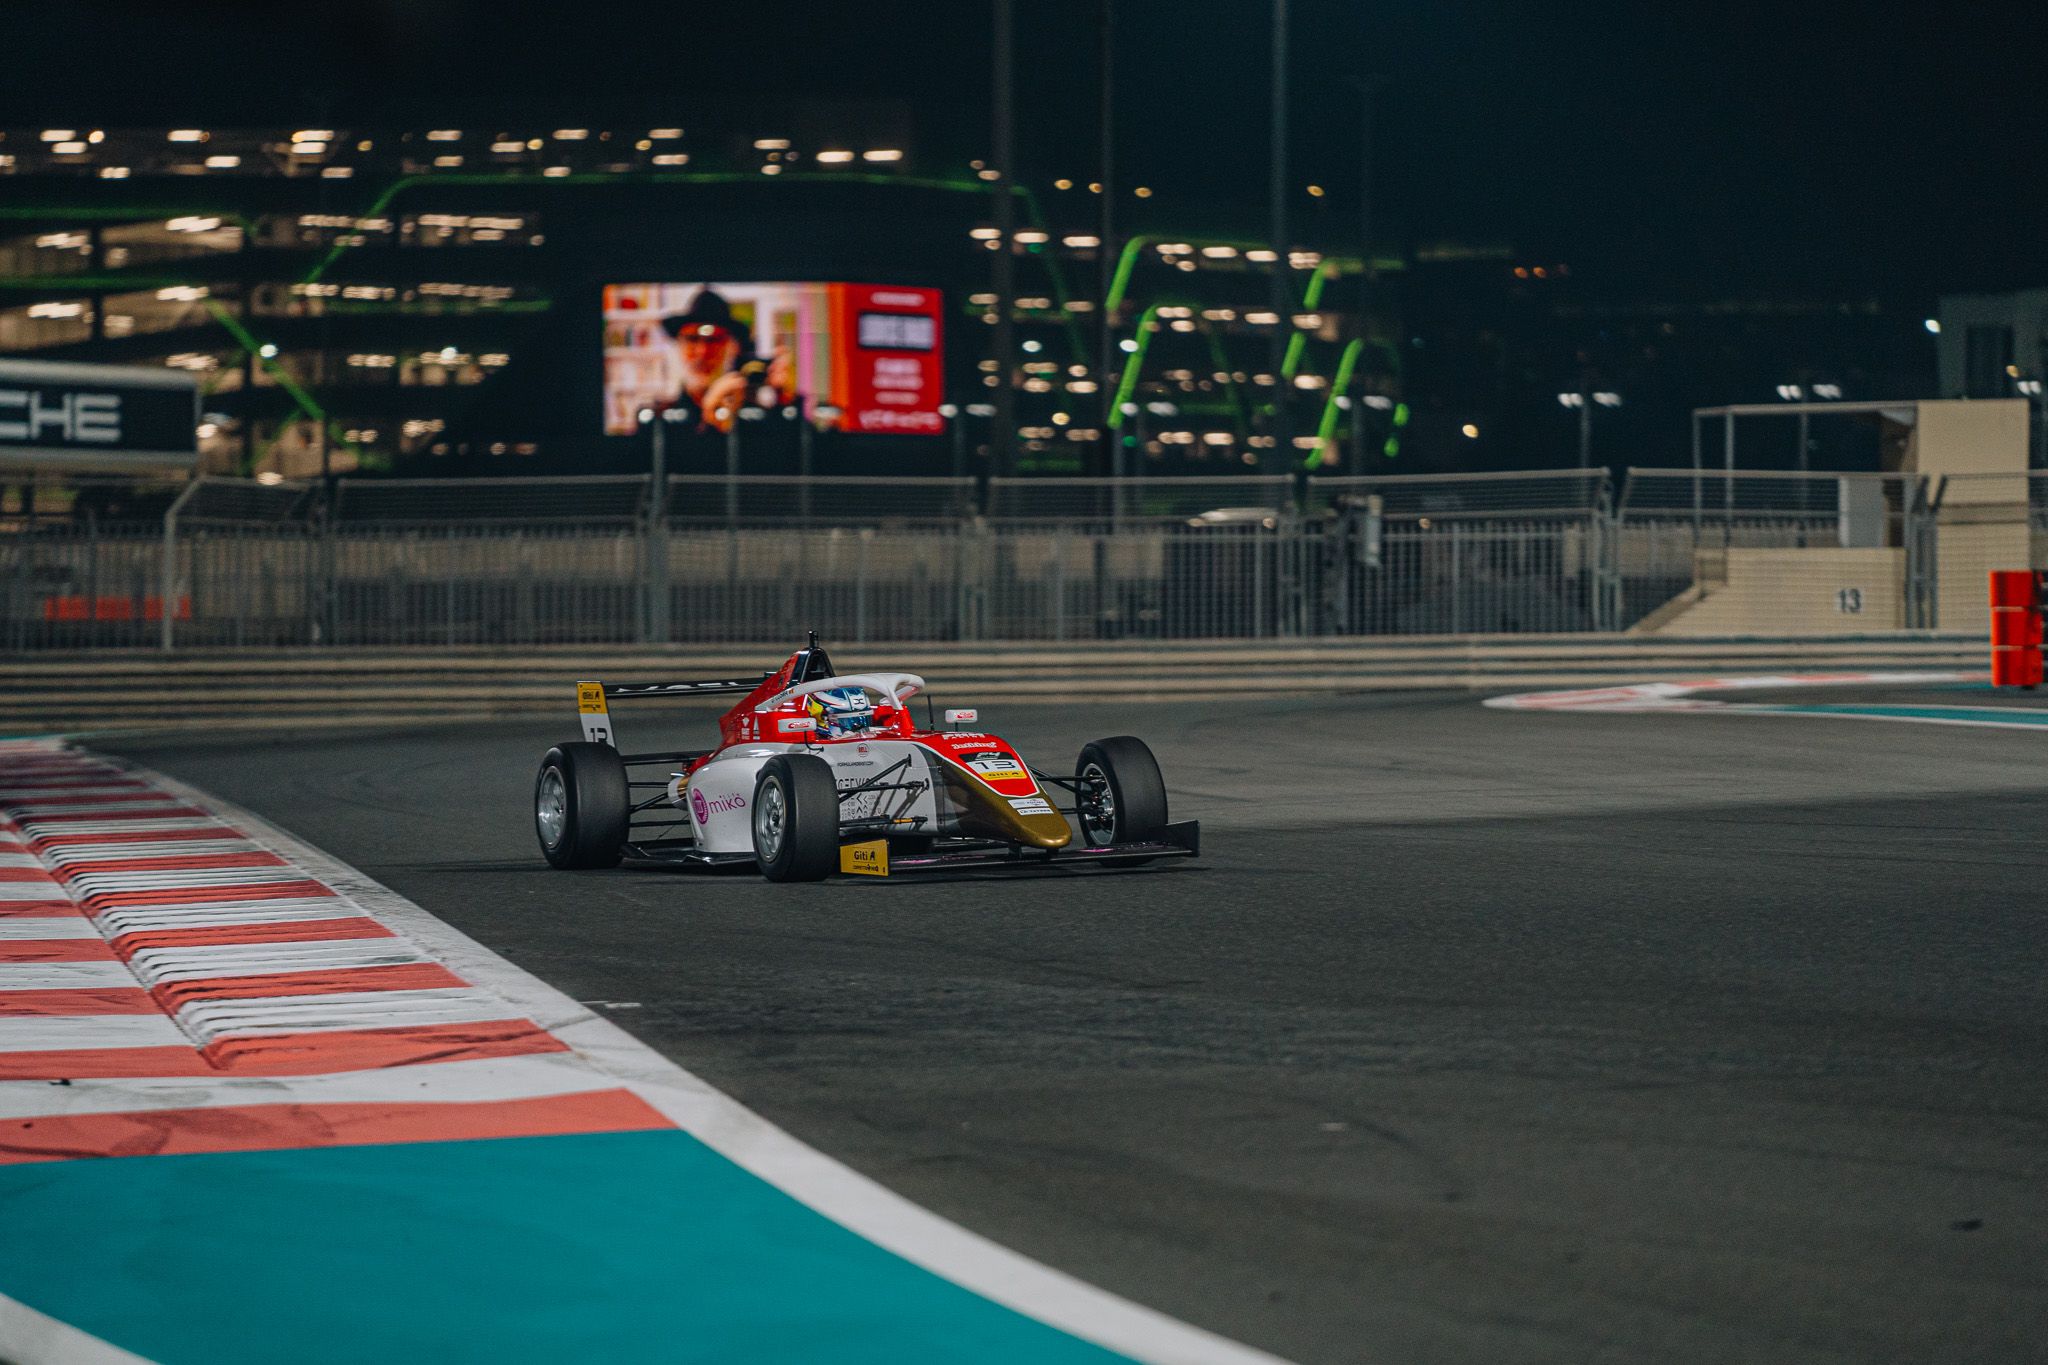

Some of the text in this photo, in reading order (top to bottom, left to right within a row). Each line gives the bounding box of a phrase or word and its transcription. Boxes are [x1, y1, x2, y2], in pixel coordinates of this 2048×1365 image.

[1839, 588, 1862, 613] 13
[975, 760, 1016, 770] 13
[854, 850, 868, 861] Giti
